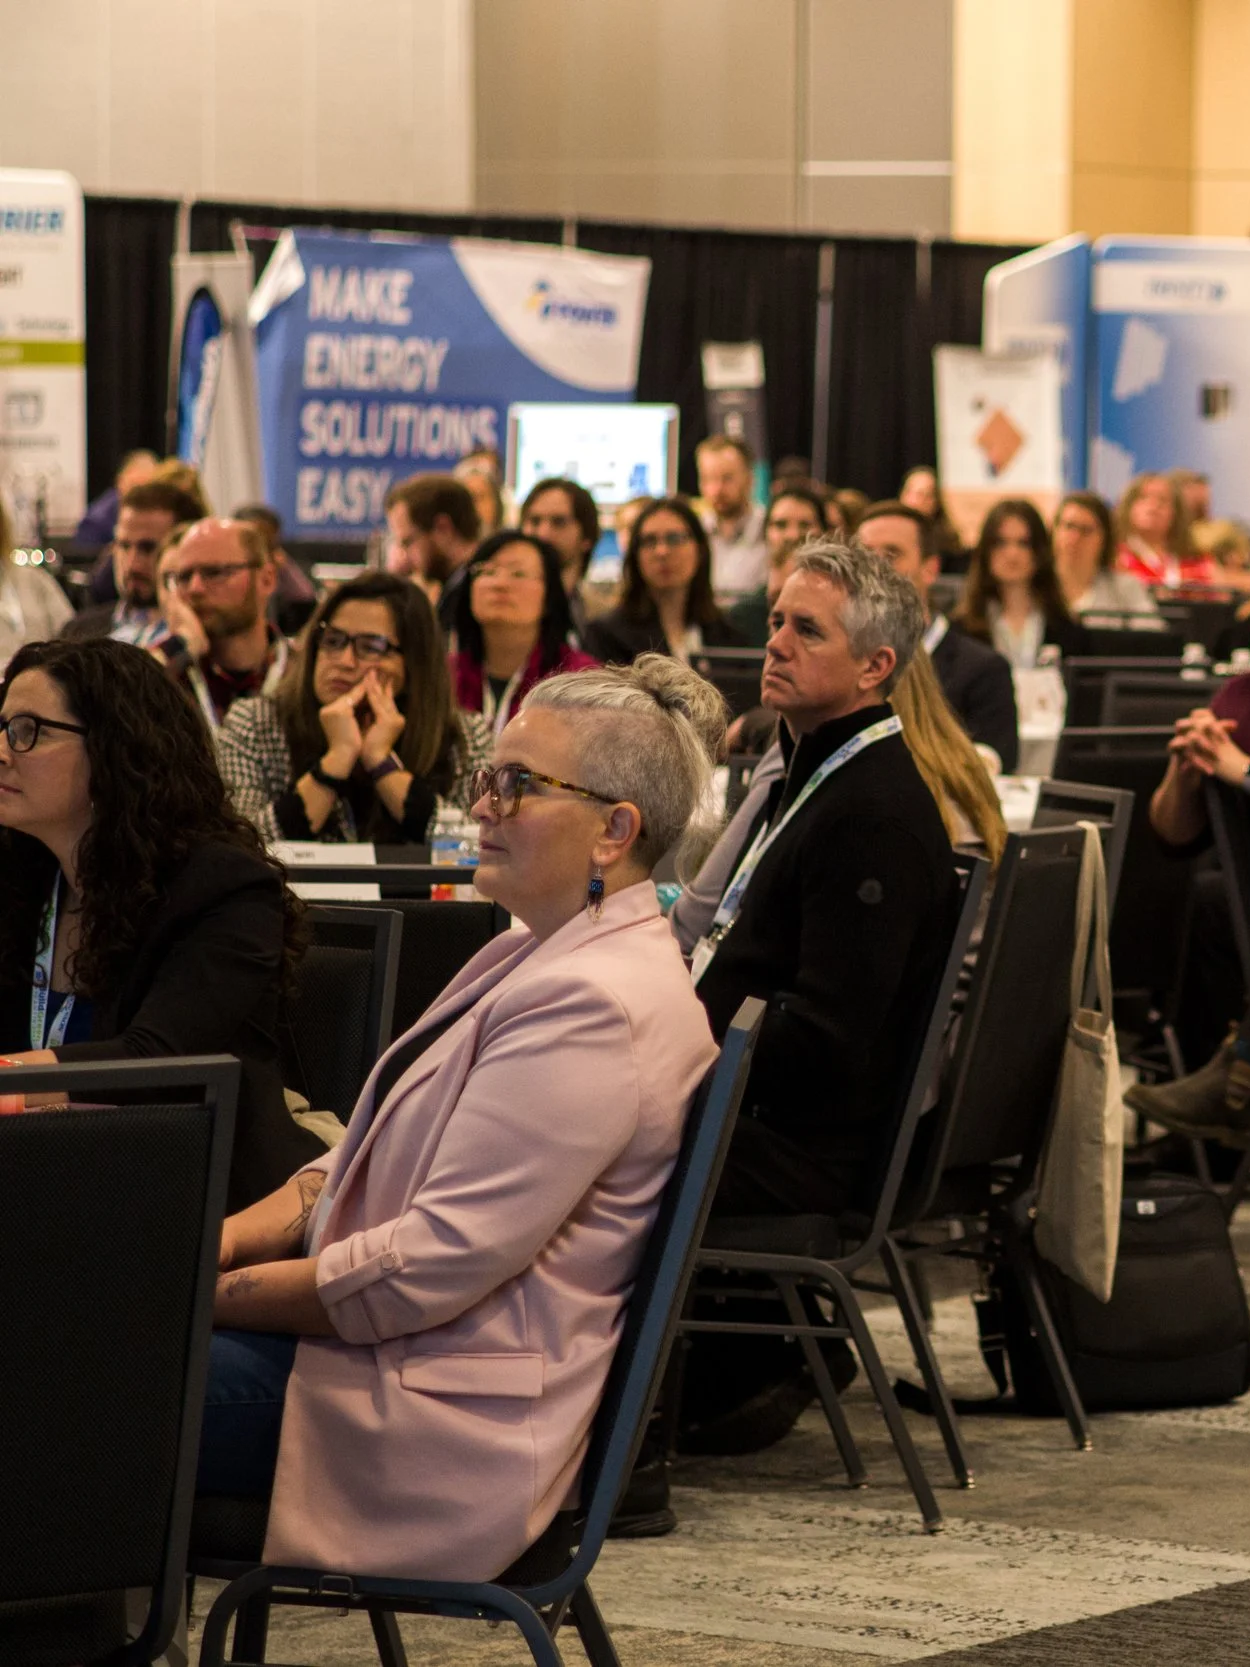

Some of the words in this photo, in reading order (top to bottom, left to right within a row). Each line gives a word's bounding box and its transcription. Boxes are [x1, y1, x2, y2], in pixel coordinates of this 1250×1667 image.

[309, 266, 413, 325] MAKE
[304, 332, 448, 392] ENERGY
[301, 401, 497, 458] SOLUTIONS
[297, 467, 391, 524] EASY
